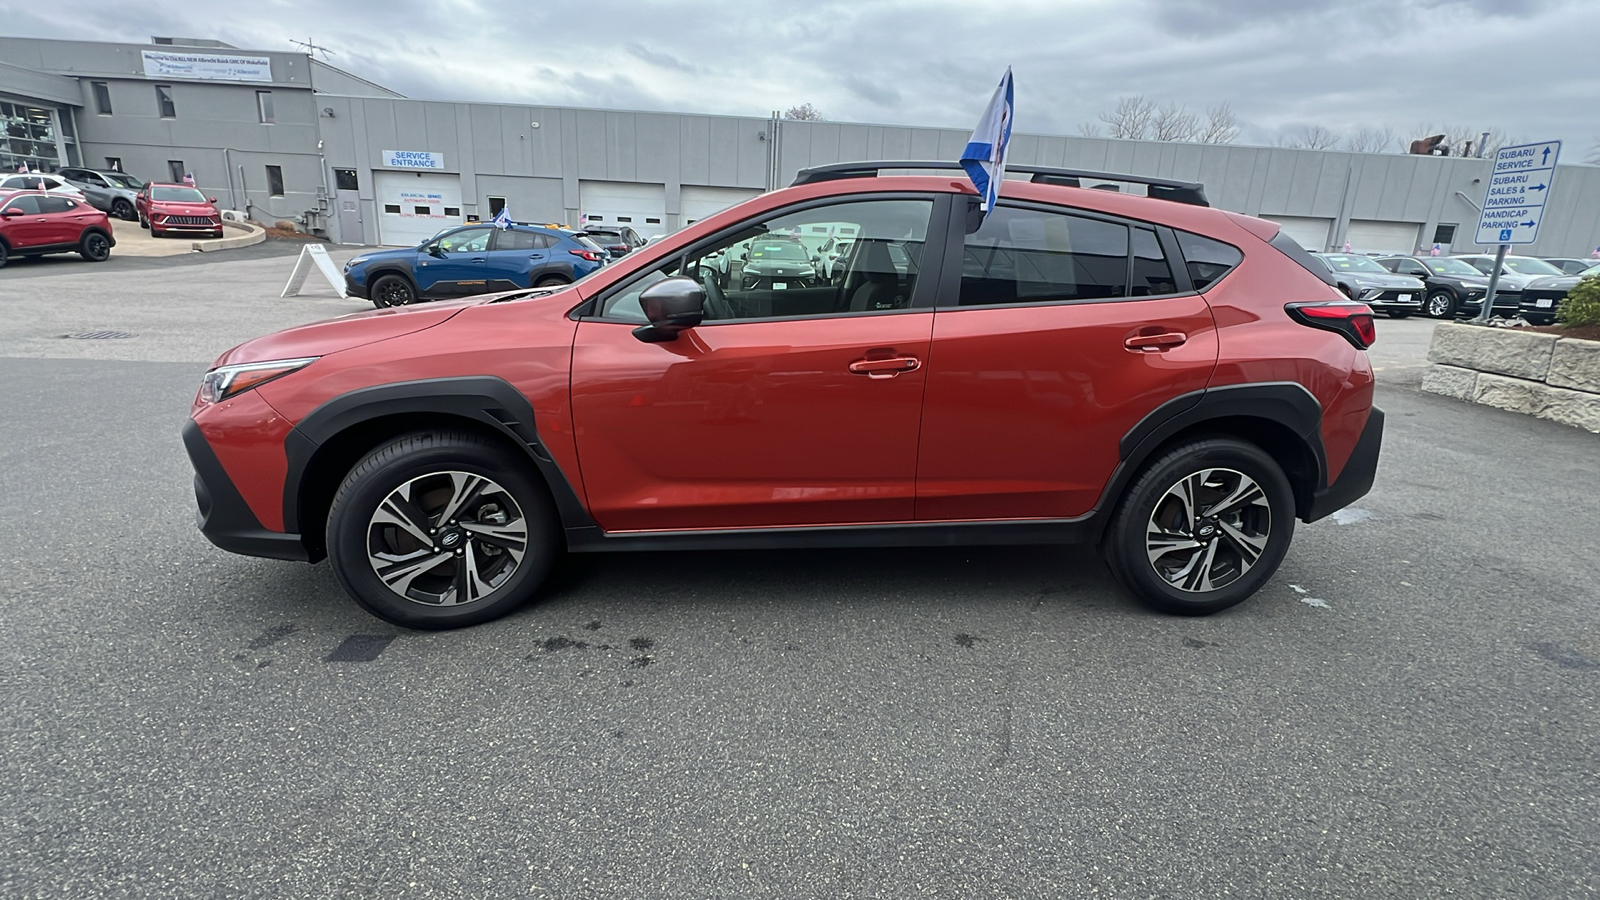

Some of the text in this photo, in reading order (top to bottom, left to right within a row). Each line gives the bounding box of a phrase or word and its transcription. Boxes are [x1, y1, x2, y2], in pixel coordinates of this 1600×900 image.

[395, 151, 430, 160] SERVICE
[1500, 148, 1535, 159] SUBARU
[391, 158, 435, 167] ENTRANCE
[1497, 159, 1533, 170] SERVICE
[1493, 175, 1529, 185] SUBARU
[1490, 186, 1518, 196] SALES
[1487, 196, 1525, 206] PARKING
[1484, 210, 1527, 218] HANDICAP
[1481, 221, 1518, 229] PARKING
